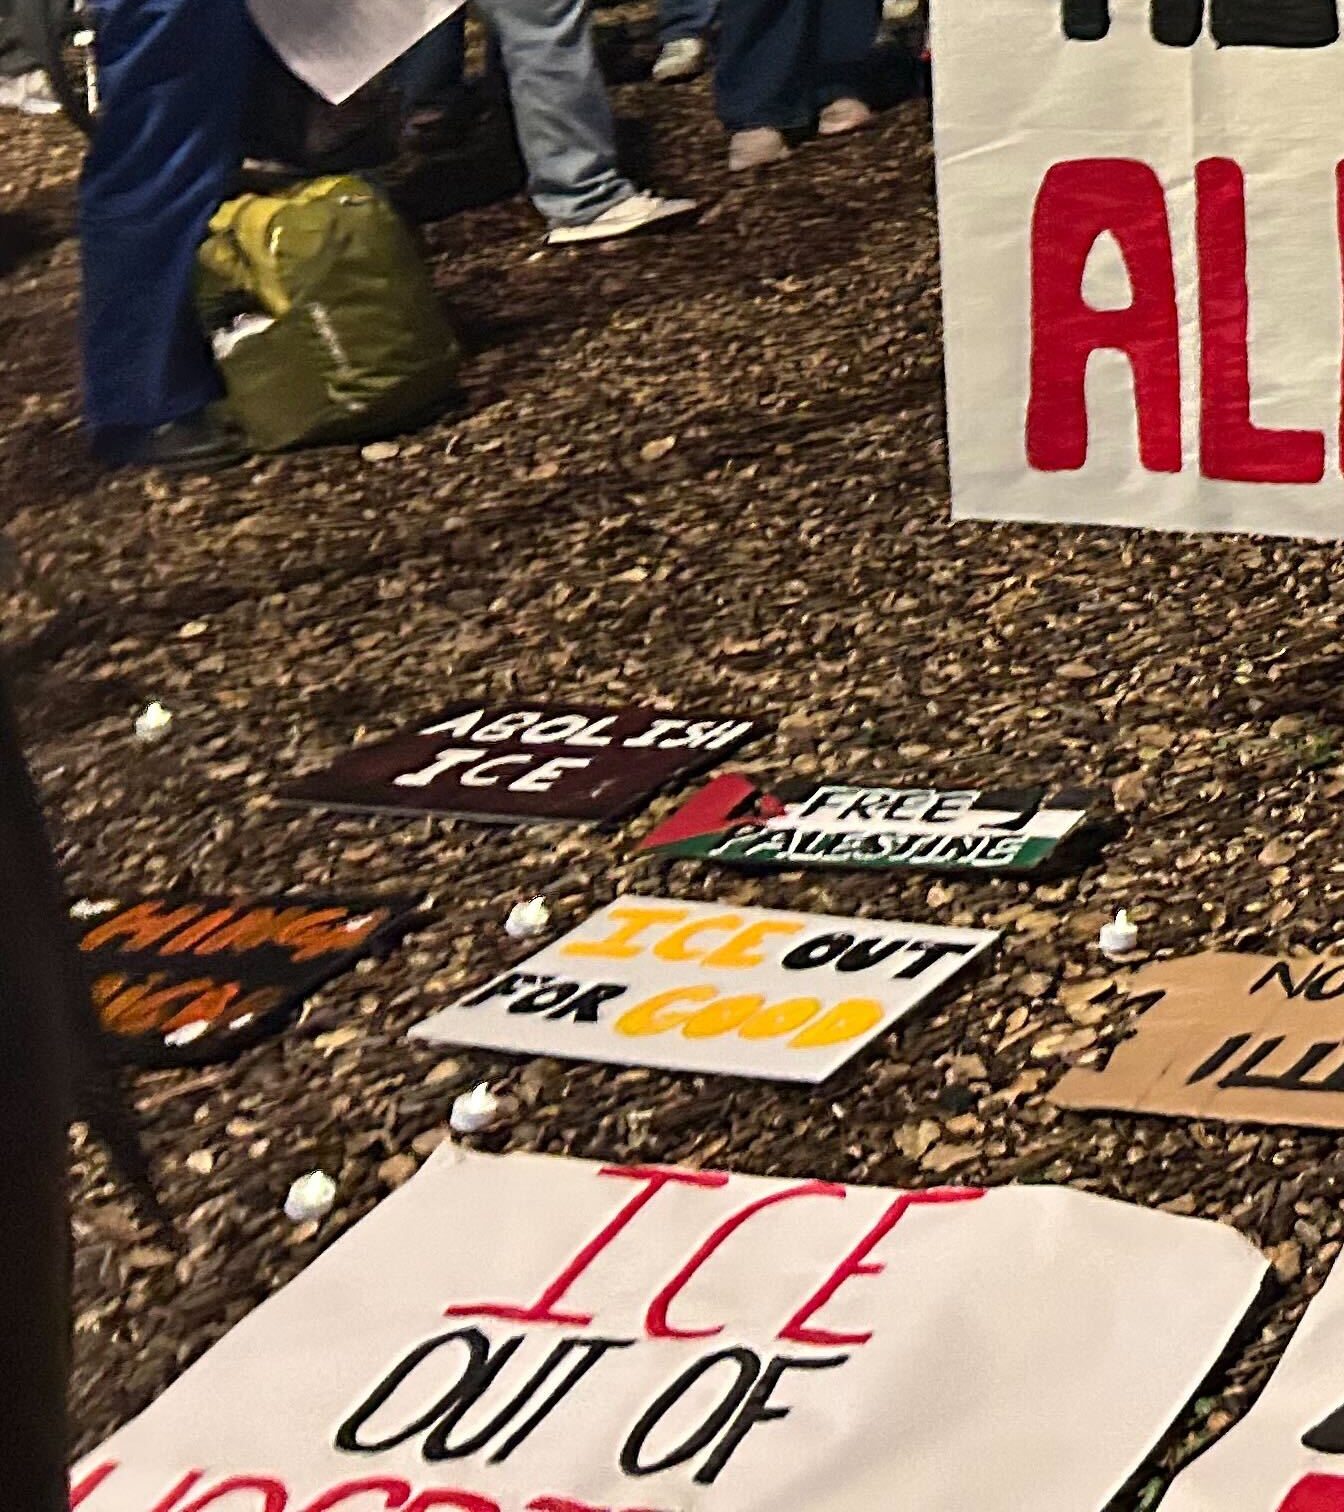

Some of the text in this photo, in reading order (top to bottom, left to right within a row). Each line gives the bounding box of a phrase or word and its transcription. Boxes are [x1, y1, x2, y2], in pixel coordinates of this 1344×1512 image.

[420, 709, 755, 751] ABOLISH
[392, 747, 593, 792] ICE
[798, 786, 982, 824] FREE
[706, 824, 1026, 867] PALESTINE
[559, 907, 977, 980] ICE OUT
[458, 972, 885, 1049] FOR GOOD
[445, 1163, 988, 1348] ICE
[333, 1327, 849, 1486] OUT OF
